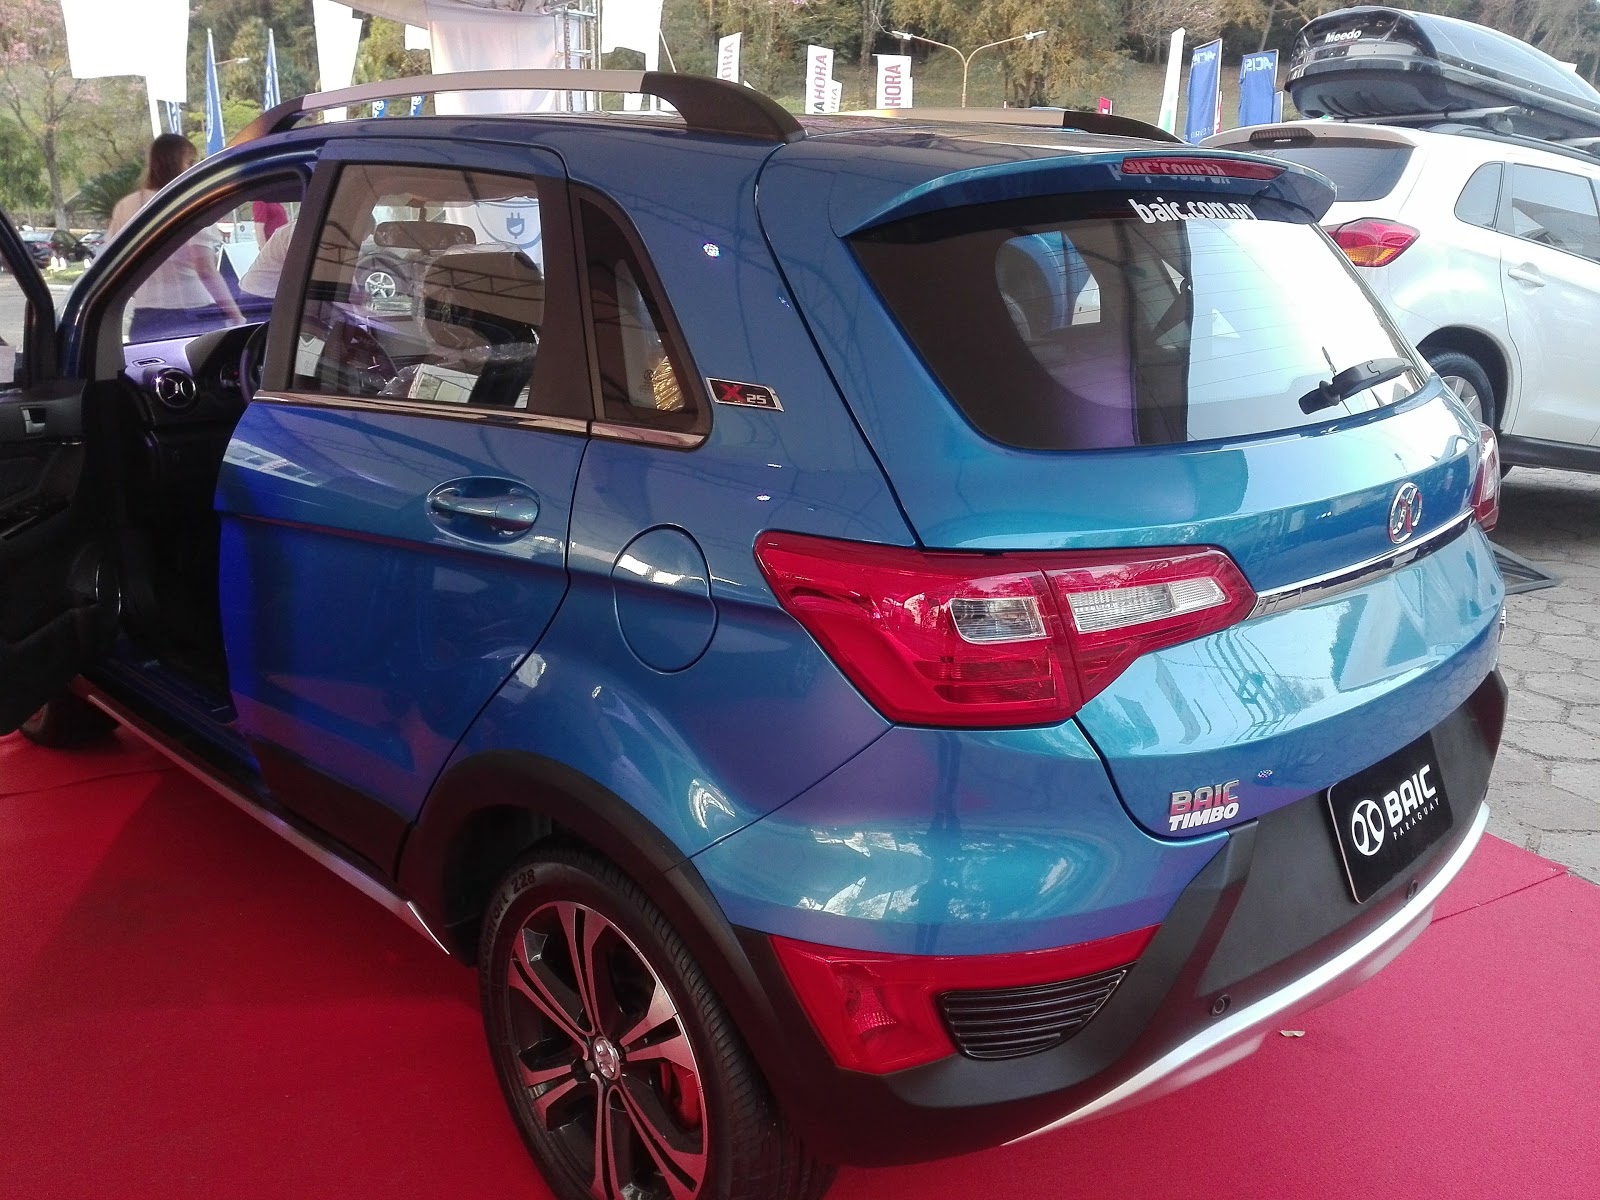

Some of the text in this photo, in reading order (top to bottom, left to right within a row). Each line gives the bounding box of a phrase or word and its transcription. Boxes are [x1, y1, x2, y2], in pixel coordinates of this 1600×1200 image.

[1324, 28, 1363, 43] Meedo
[884, 63, 902, 107] HORA
[1127, 196, 1259, 224] baic.com.py
[720, 383, 767, 405] X 25
[1170, 779, 1240, 815] BAIC
[1383, 764, 1438, 827] BAIC
[1169, 802, 1240, 831] TIMBO
[1393, 797, 1440, 841] PARAGUAY
[511, 868, 536, 894] 228
